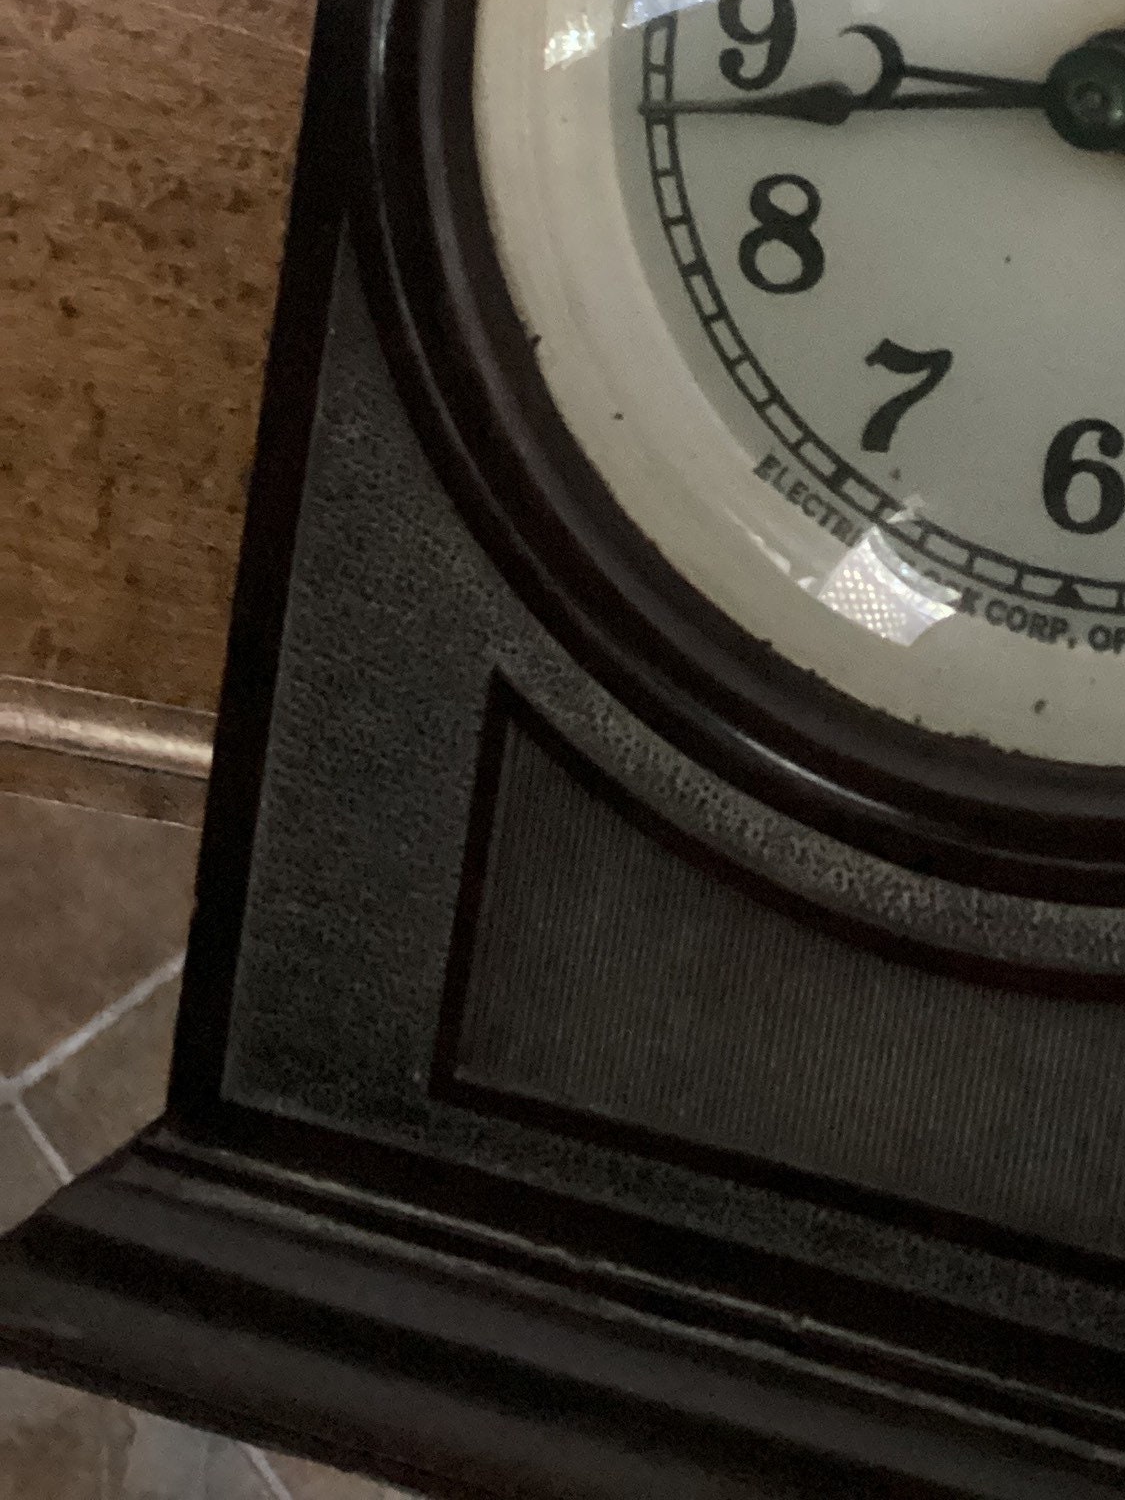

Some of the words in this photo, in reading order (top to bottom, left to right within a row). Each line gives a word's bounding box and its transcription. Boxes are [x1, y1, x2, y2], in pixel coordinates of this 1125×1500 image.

[737, 172, 826, 295] 8
[859, 337, 954, 454] 7
[751, 451, 867, 550] ELECTRI
